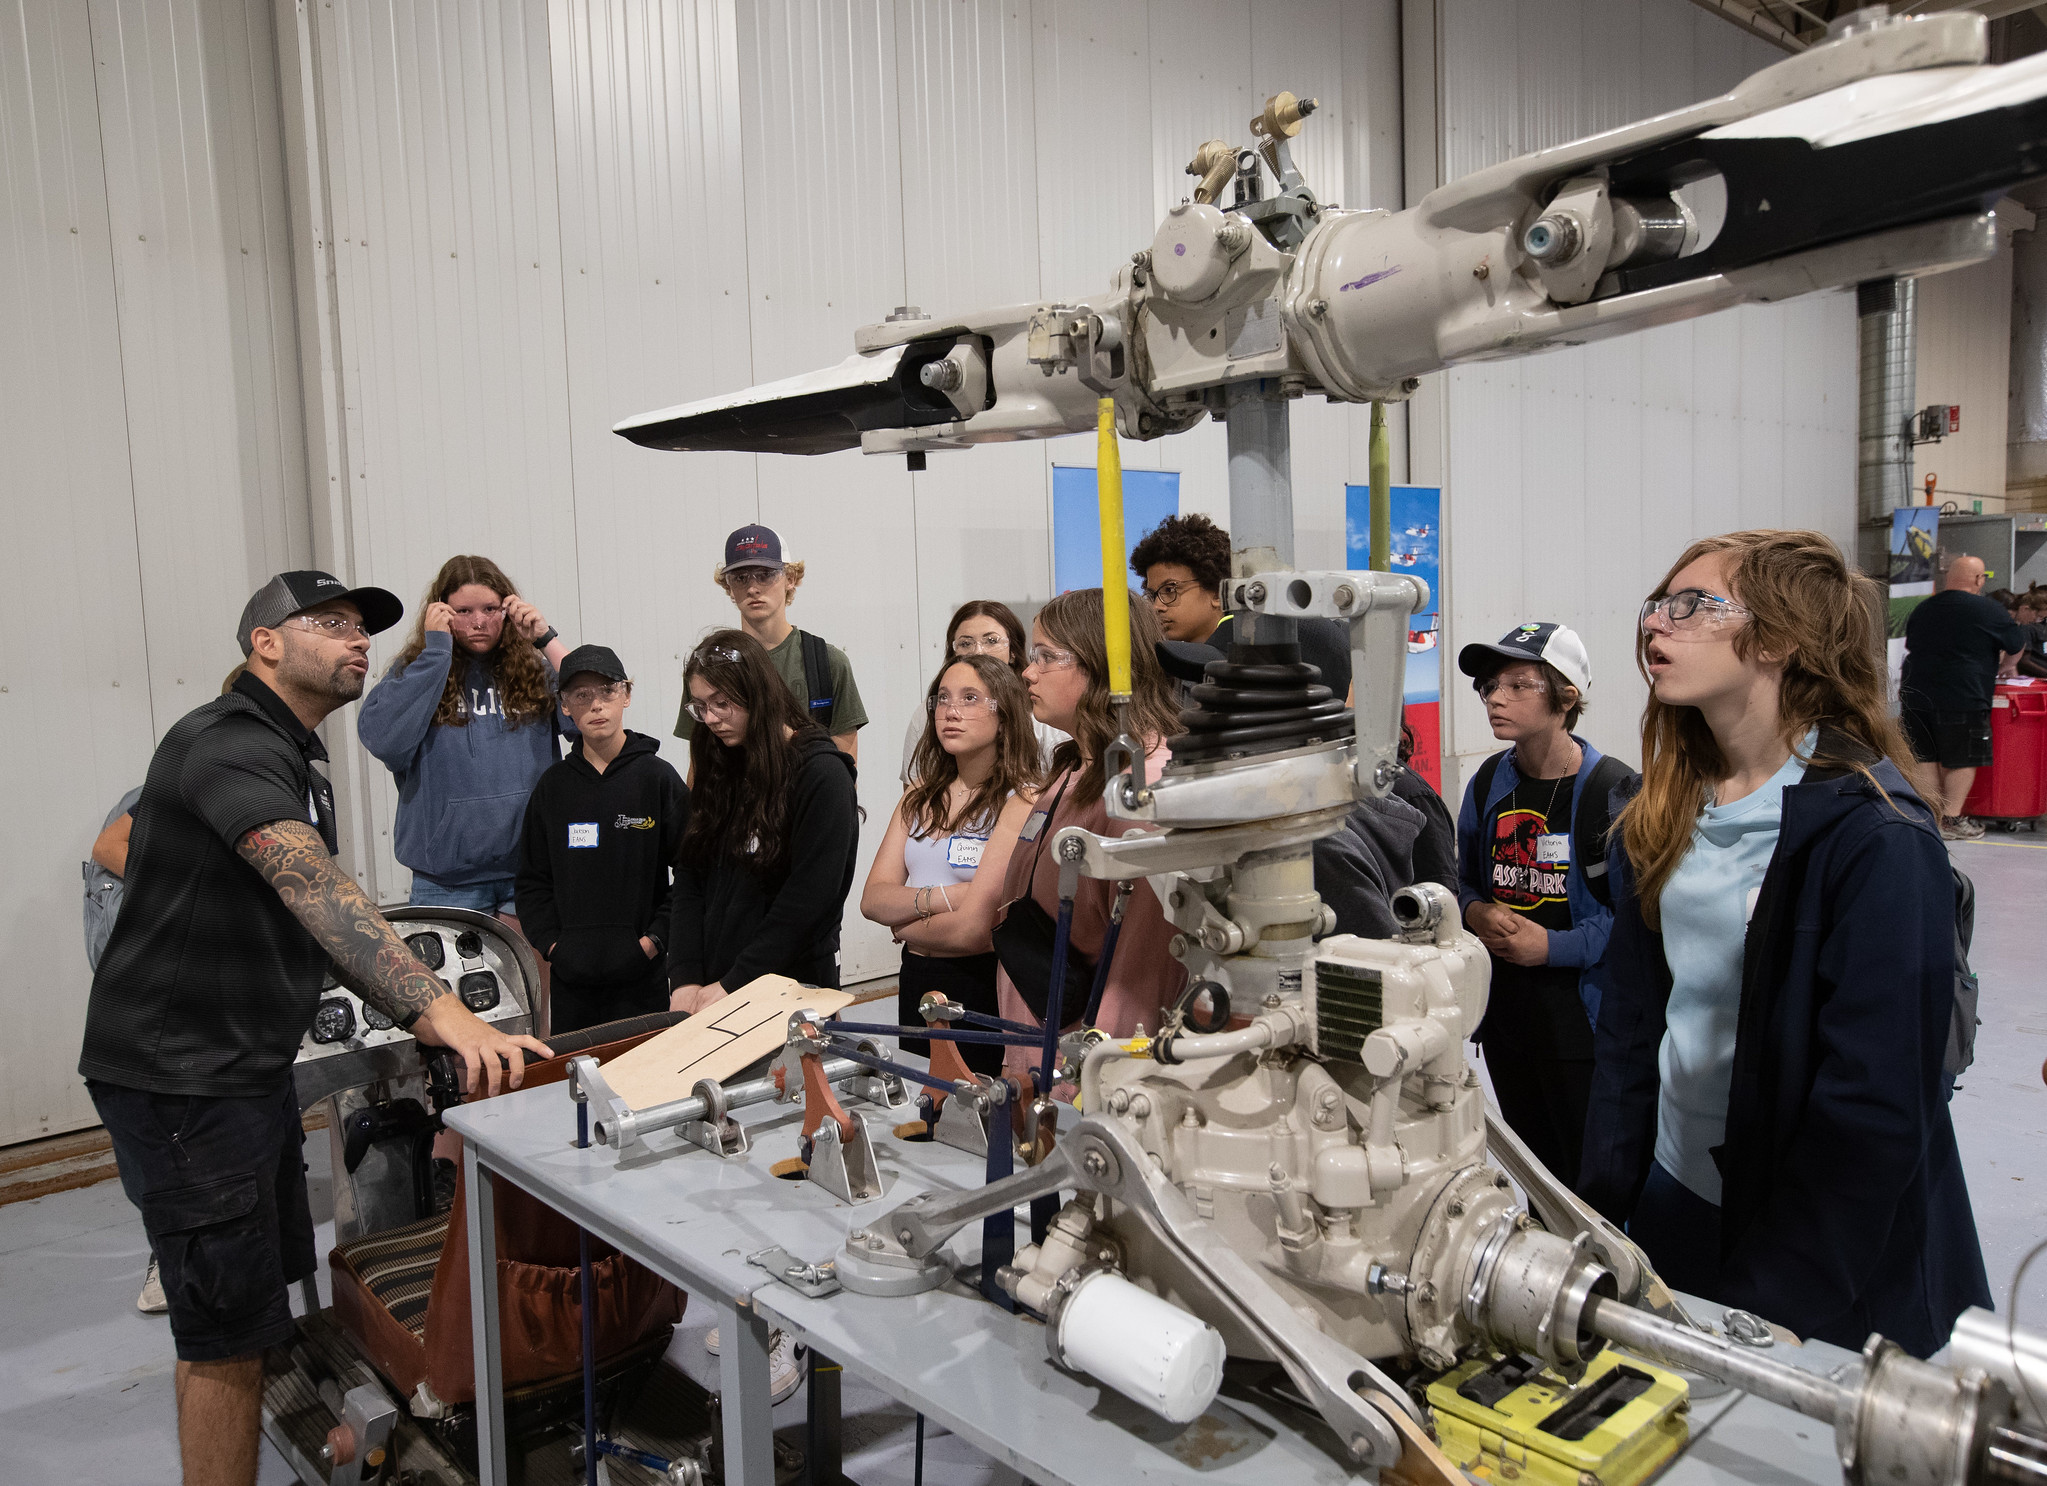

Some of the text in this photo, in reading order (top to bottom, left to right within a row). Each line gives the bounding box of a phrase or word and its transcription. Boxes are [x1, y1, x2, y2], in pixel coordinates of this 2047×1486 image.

[956, 842, 978, 852] Quinn
[957, 855, 977, 863] EAMS
[1529, 867, 1567, 894] PARK
